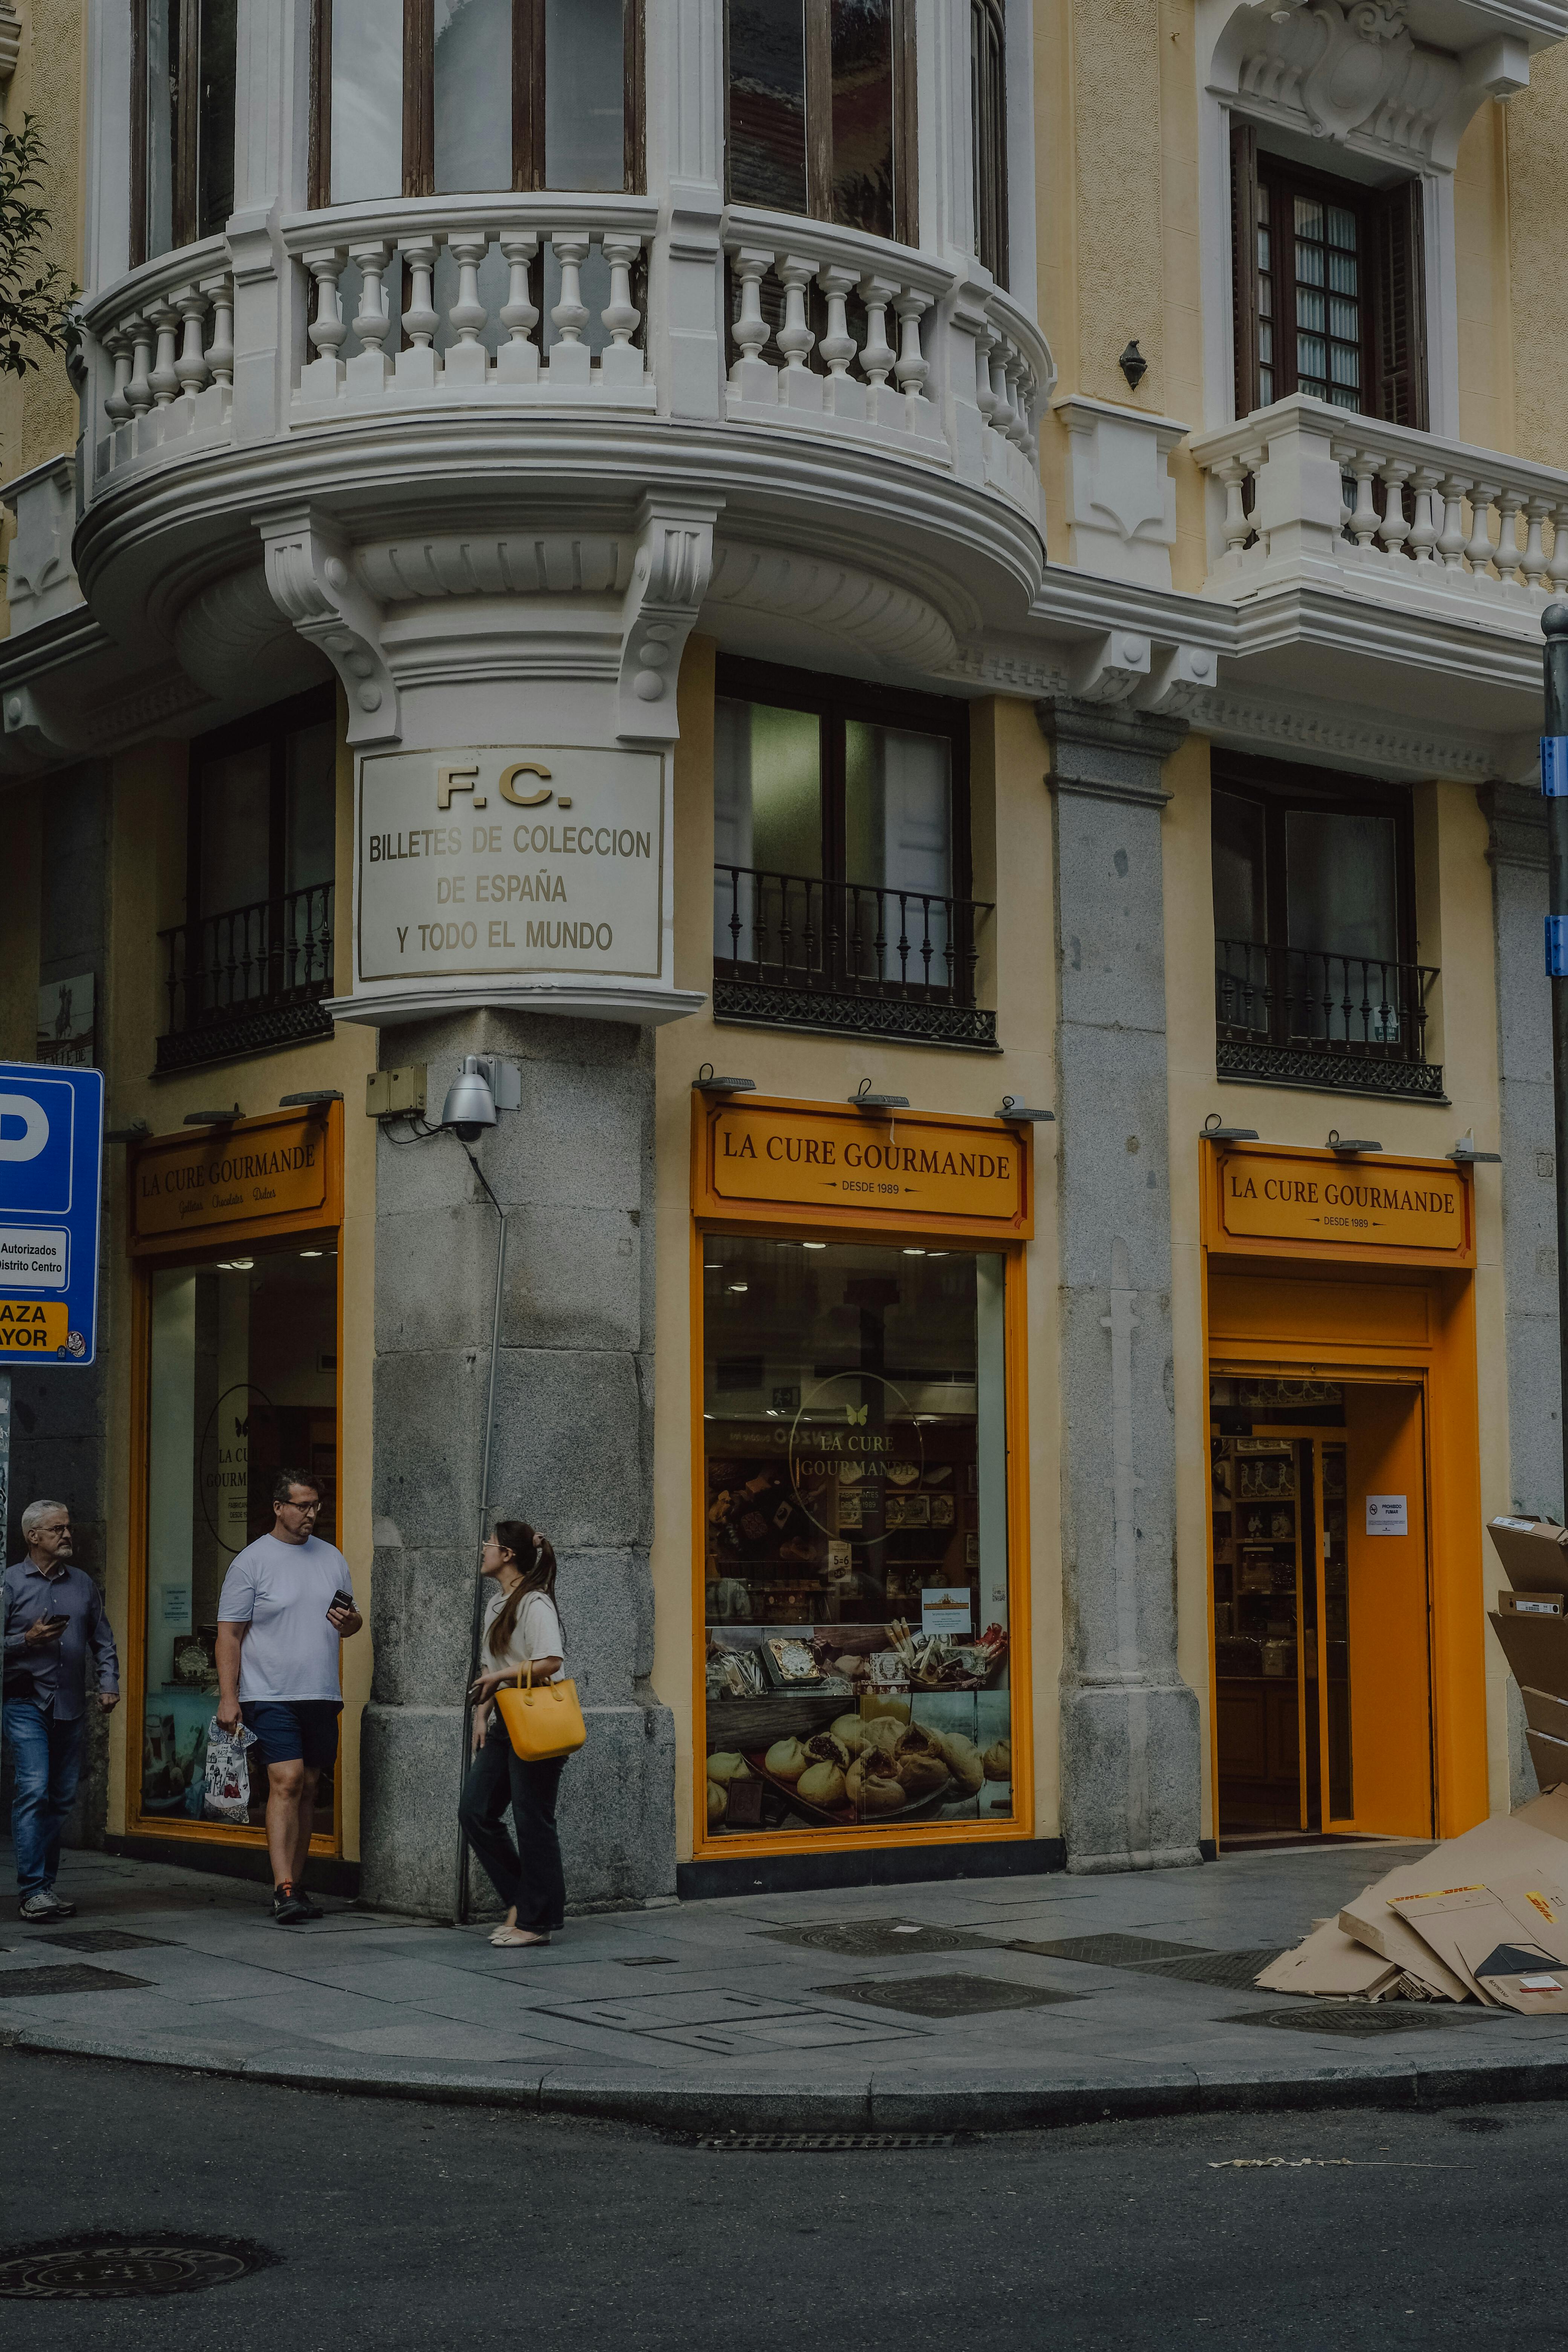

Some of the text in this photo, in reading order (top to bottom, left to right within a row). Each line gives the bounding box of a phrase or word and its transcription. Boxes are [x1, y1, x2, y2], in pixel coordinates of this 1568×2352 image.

[437, 762, 572, 809] F.C.
[370, 825, 651, 862] BILLETES DE COLECCION
[437, 869, 567, 904] DE ESPAÑA
[397, 921, 613, 953] Y TODO EL MUNDO
[723, 1132, 1010, 1179] LA CURE GOURMANDE
[142, 1144, 315, 1197] LA CURE GOURMANDE
[212, 1193, 244, 1208] Chocolates
[253, 1187, 276, 1200] Dulces
[842, 1181, 899, 1194] DESDE 1989
[1231, 1176, 1455, 1213] LA CURE GOURMANDE
[1324, 1216, 1368, 1228] DESDE 1989
[1, 1243, 57, 1256] Autorizados
[32, 1261, 62, 1272] Centro
[820, 1436, 894, 1451] LA CURE
[219, 1449, 232, 1463] LA
[801, 1460, 913, 1476] GOURMANDE
[207, 1472, 246, 1487] GOURM
[1530, 1898, 1553, 1920] DHL
